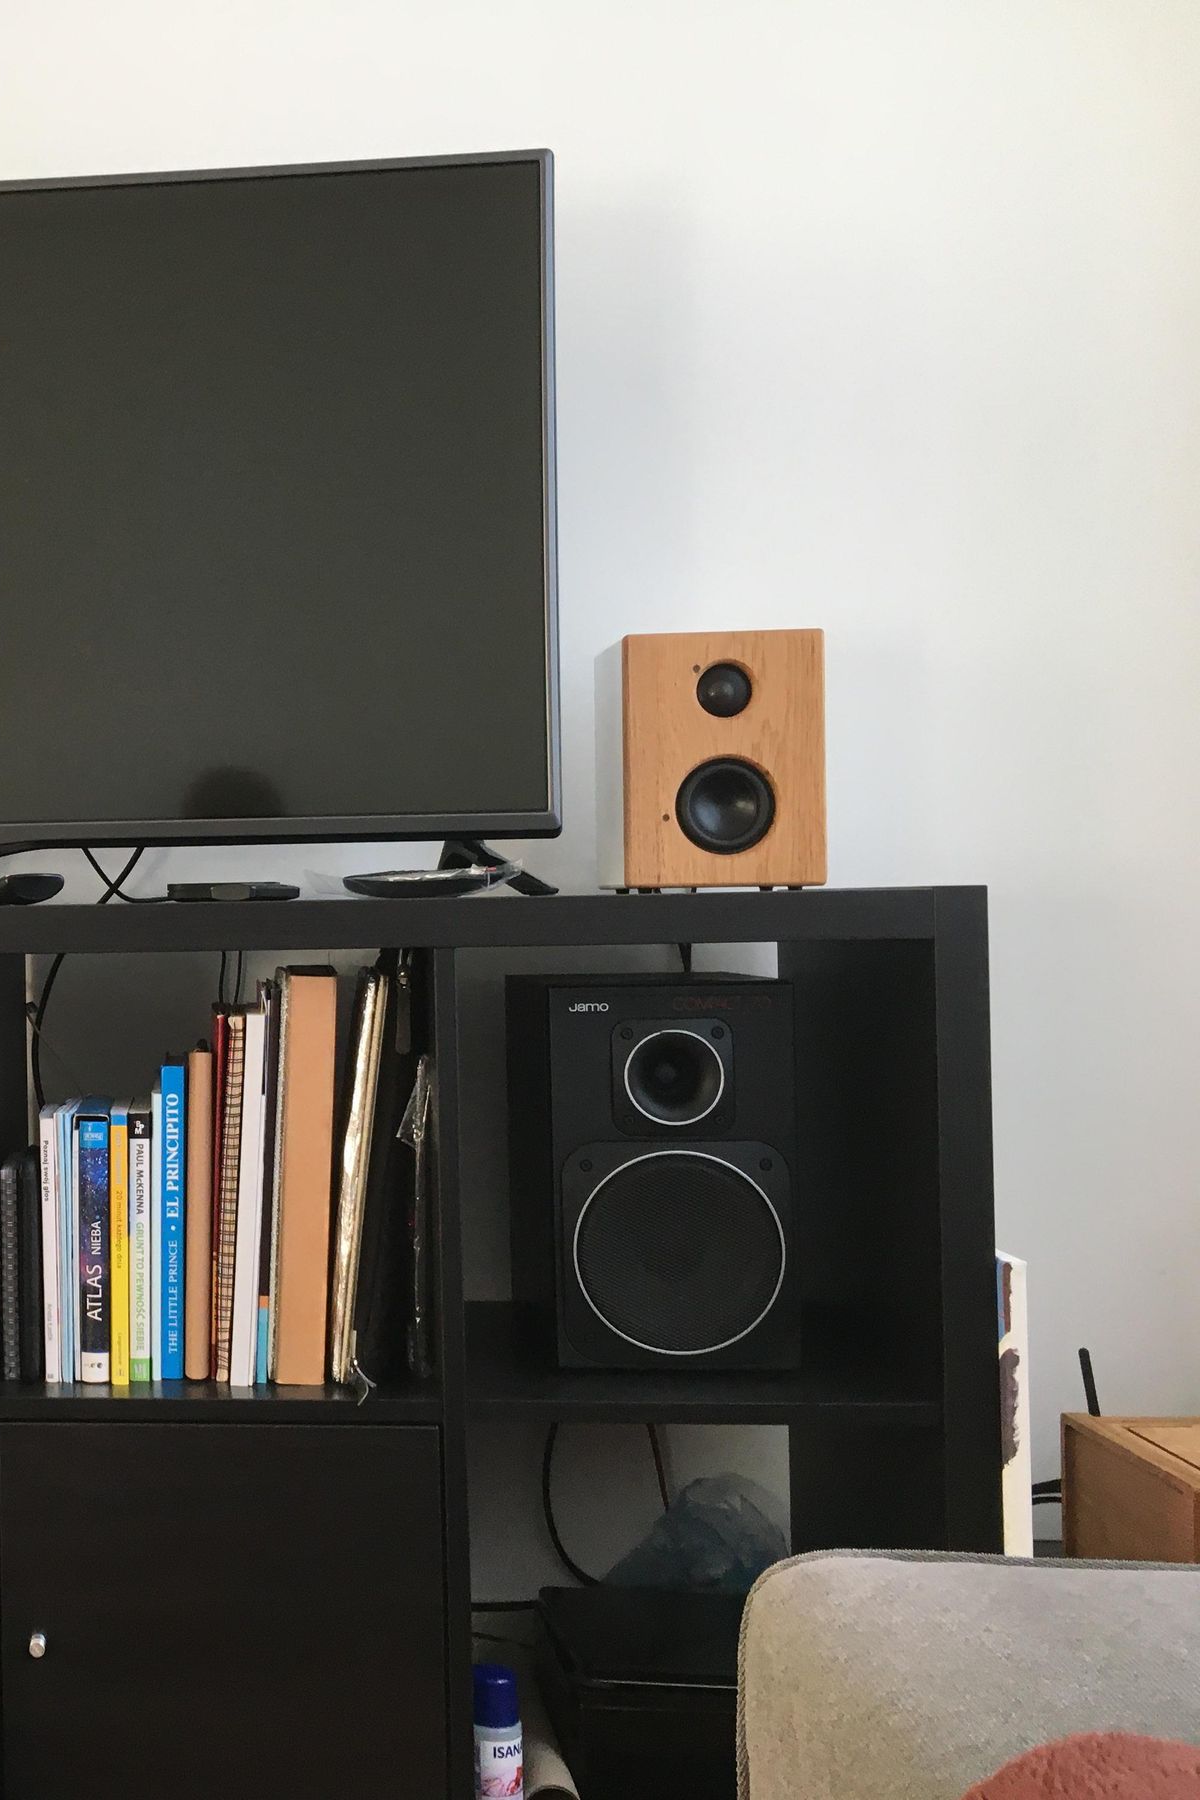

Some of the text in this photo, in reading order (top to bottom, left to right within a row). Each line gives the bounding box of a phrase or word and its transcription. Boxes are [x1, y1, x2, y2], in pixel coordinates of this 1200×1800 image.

[569, 1002, 609, 1012] Jamo
[41, 1140, 49, 1164] Poznaj
[136, 1143, 144, 1215] PAUL McKENNA
[165, 1093, 179, 1354] THE LITTLE PRINCE EL PRINCIPITO
[136, 1222, 144, 1255] GRUNT
[86, 1221, 102, 1321] ATLAS NIEBA
[136, 1256, 144, 1270] TO
[136, 1322, 144, 1351] SIEBIE
[492, 1742, 522, 1759] ISAN
